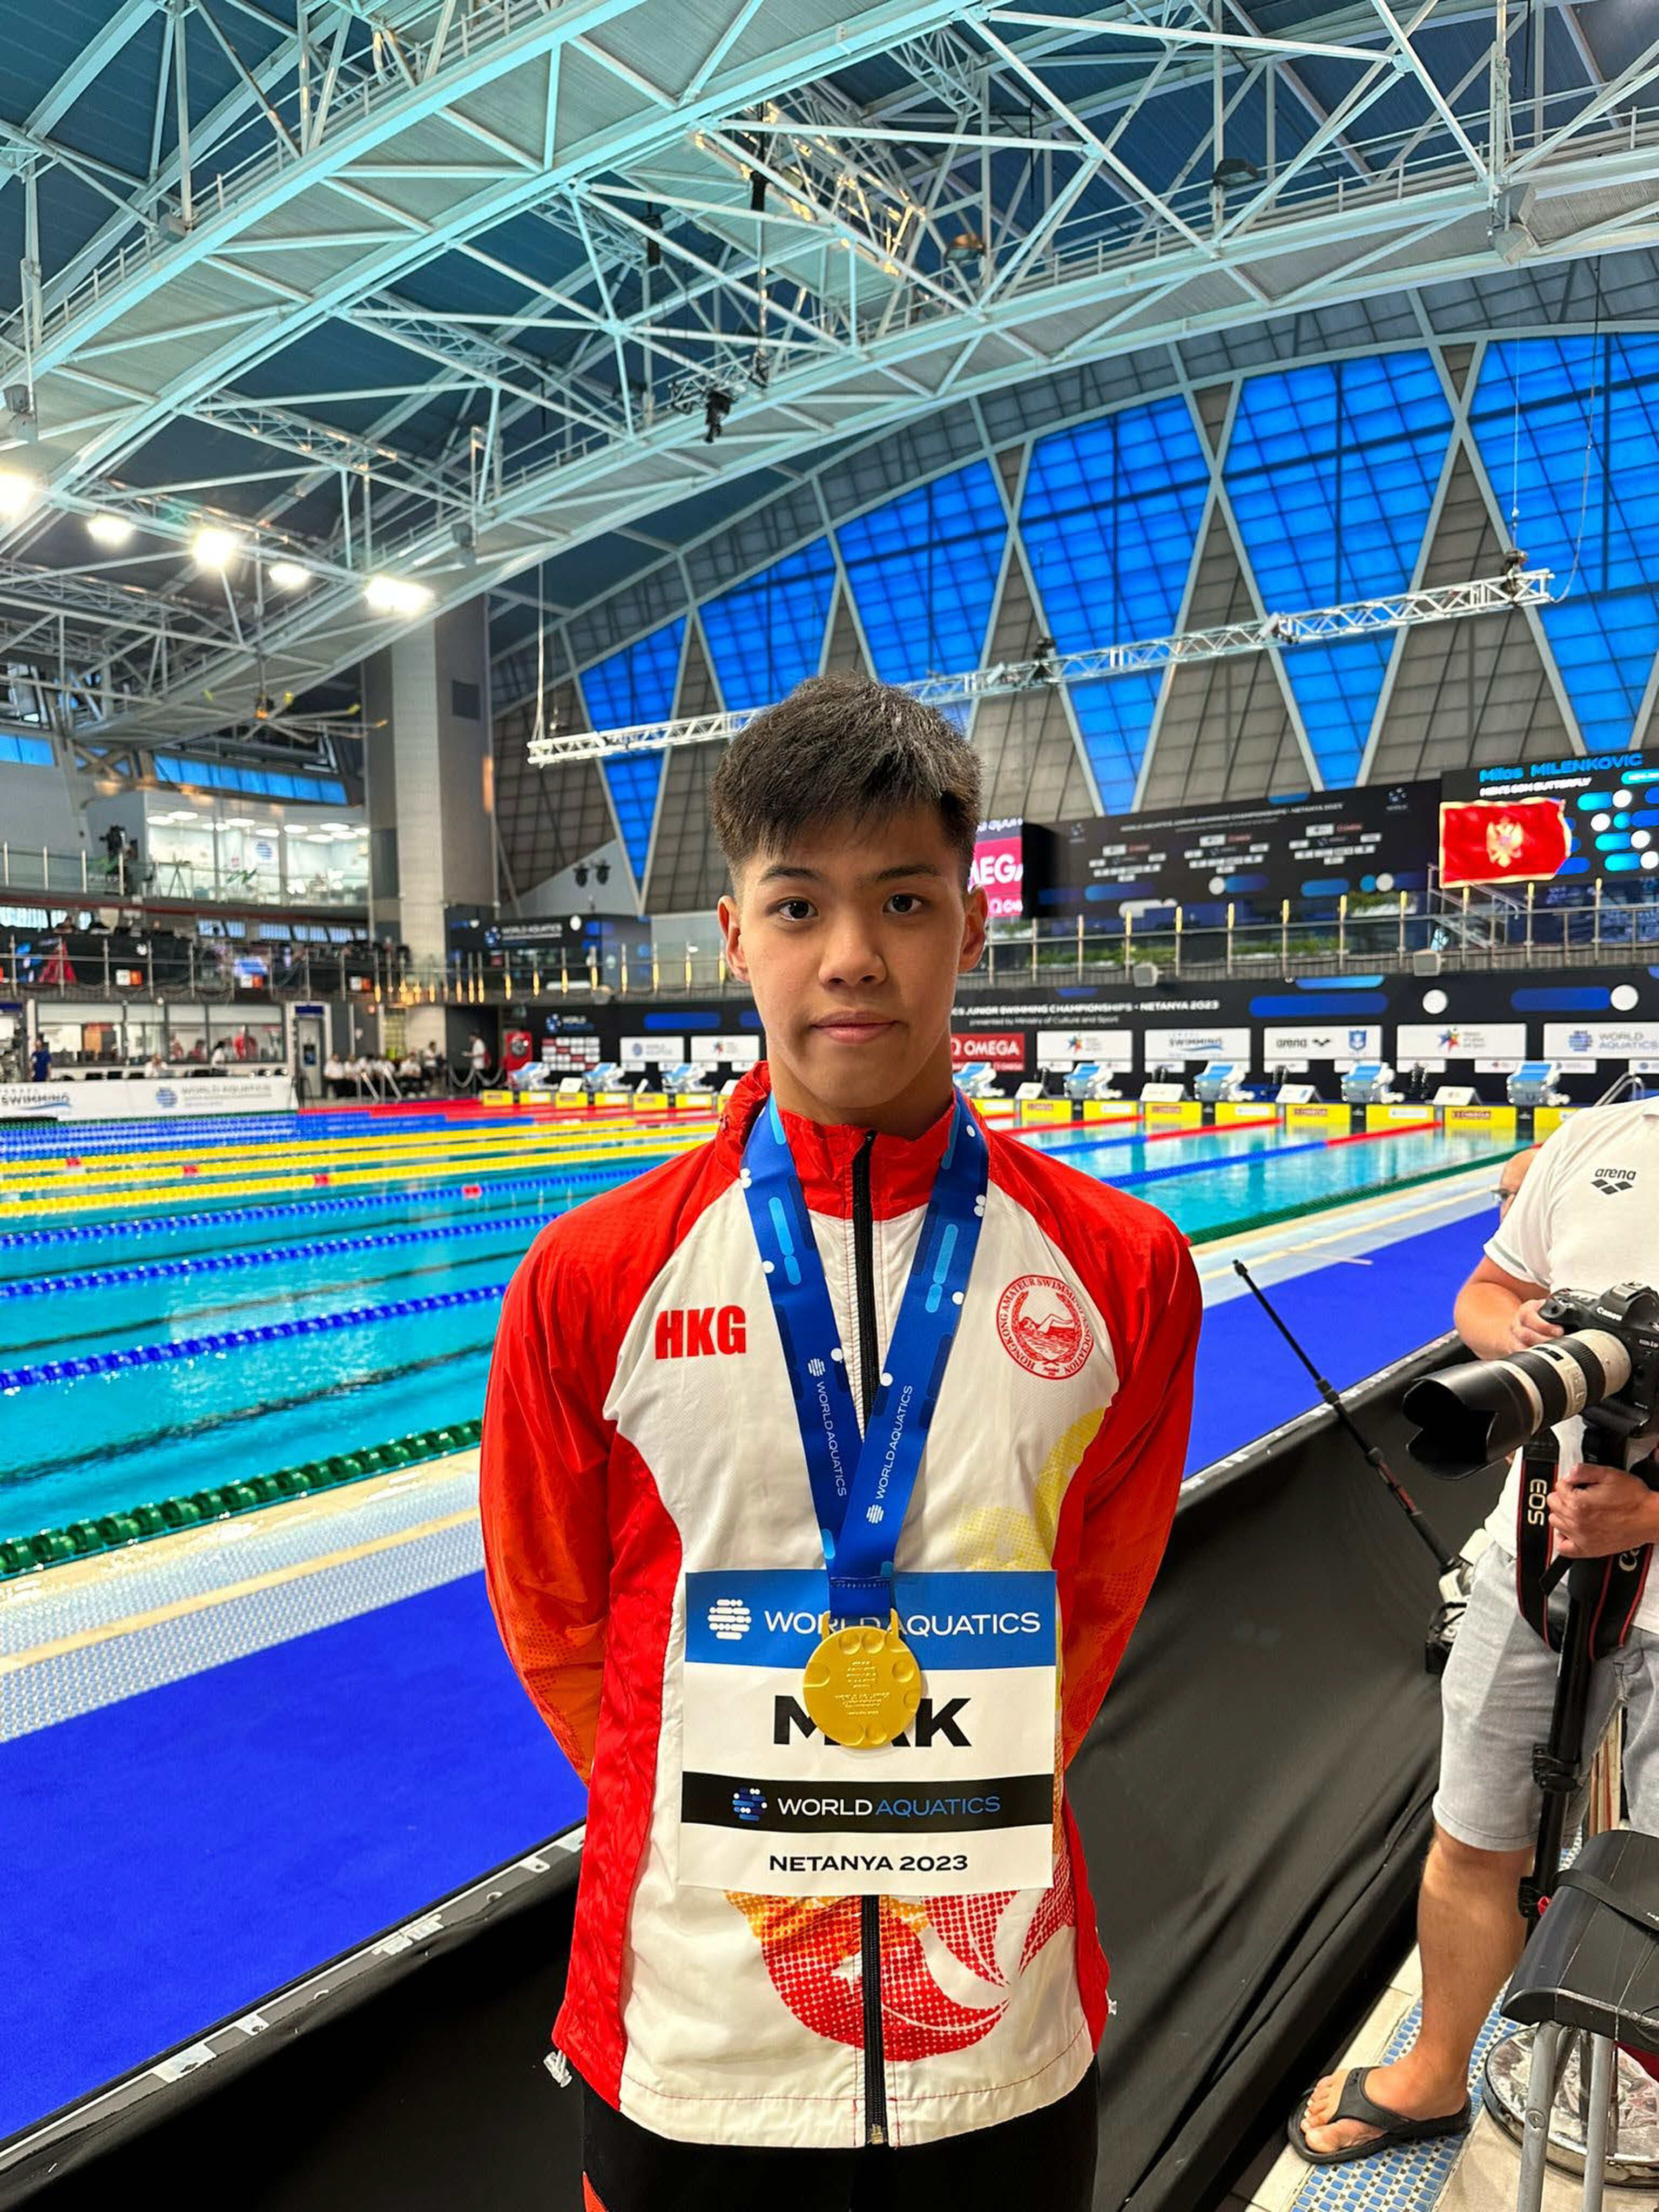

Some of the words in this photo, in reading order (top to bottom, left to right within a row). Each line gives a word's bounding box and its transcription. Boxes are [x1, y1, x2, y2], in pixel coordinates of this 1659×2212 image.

[1599, 1032, 1643, 1041] WORLD
[1599, 1042, 1659, 1051] AQUATICS
[964, 1040, 1020, 1056] OMEGA
[1595, 1168, 1636, 1181] arena
[1002, 1278, 1035, 1312] AMATEUR
[1596, 1306, 1622, 1321] Canon
[656, 1305, 746, 1359] HKG
[817, 1381, 833, 1431] WORLD
[826, 1431, 847, 1496] AQUATICS
[875, 1450, 895, 1499] WORLD
[889, 1385, 913, 1451] AQUATICS
[1528, 1479, 1547, 1526] EOS
[774, 1695, 972, 1747] MK
[778, 1798, 873, 1816] WORLD
[875, 1796, 1001, 1818] AQUATICS
[770, 1856, 893, 1872] NETANYA
[900, 1855, 968, 1871] 2023
